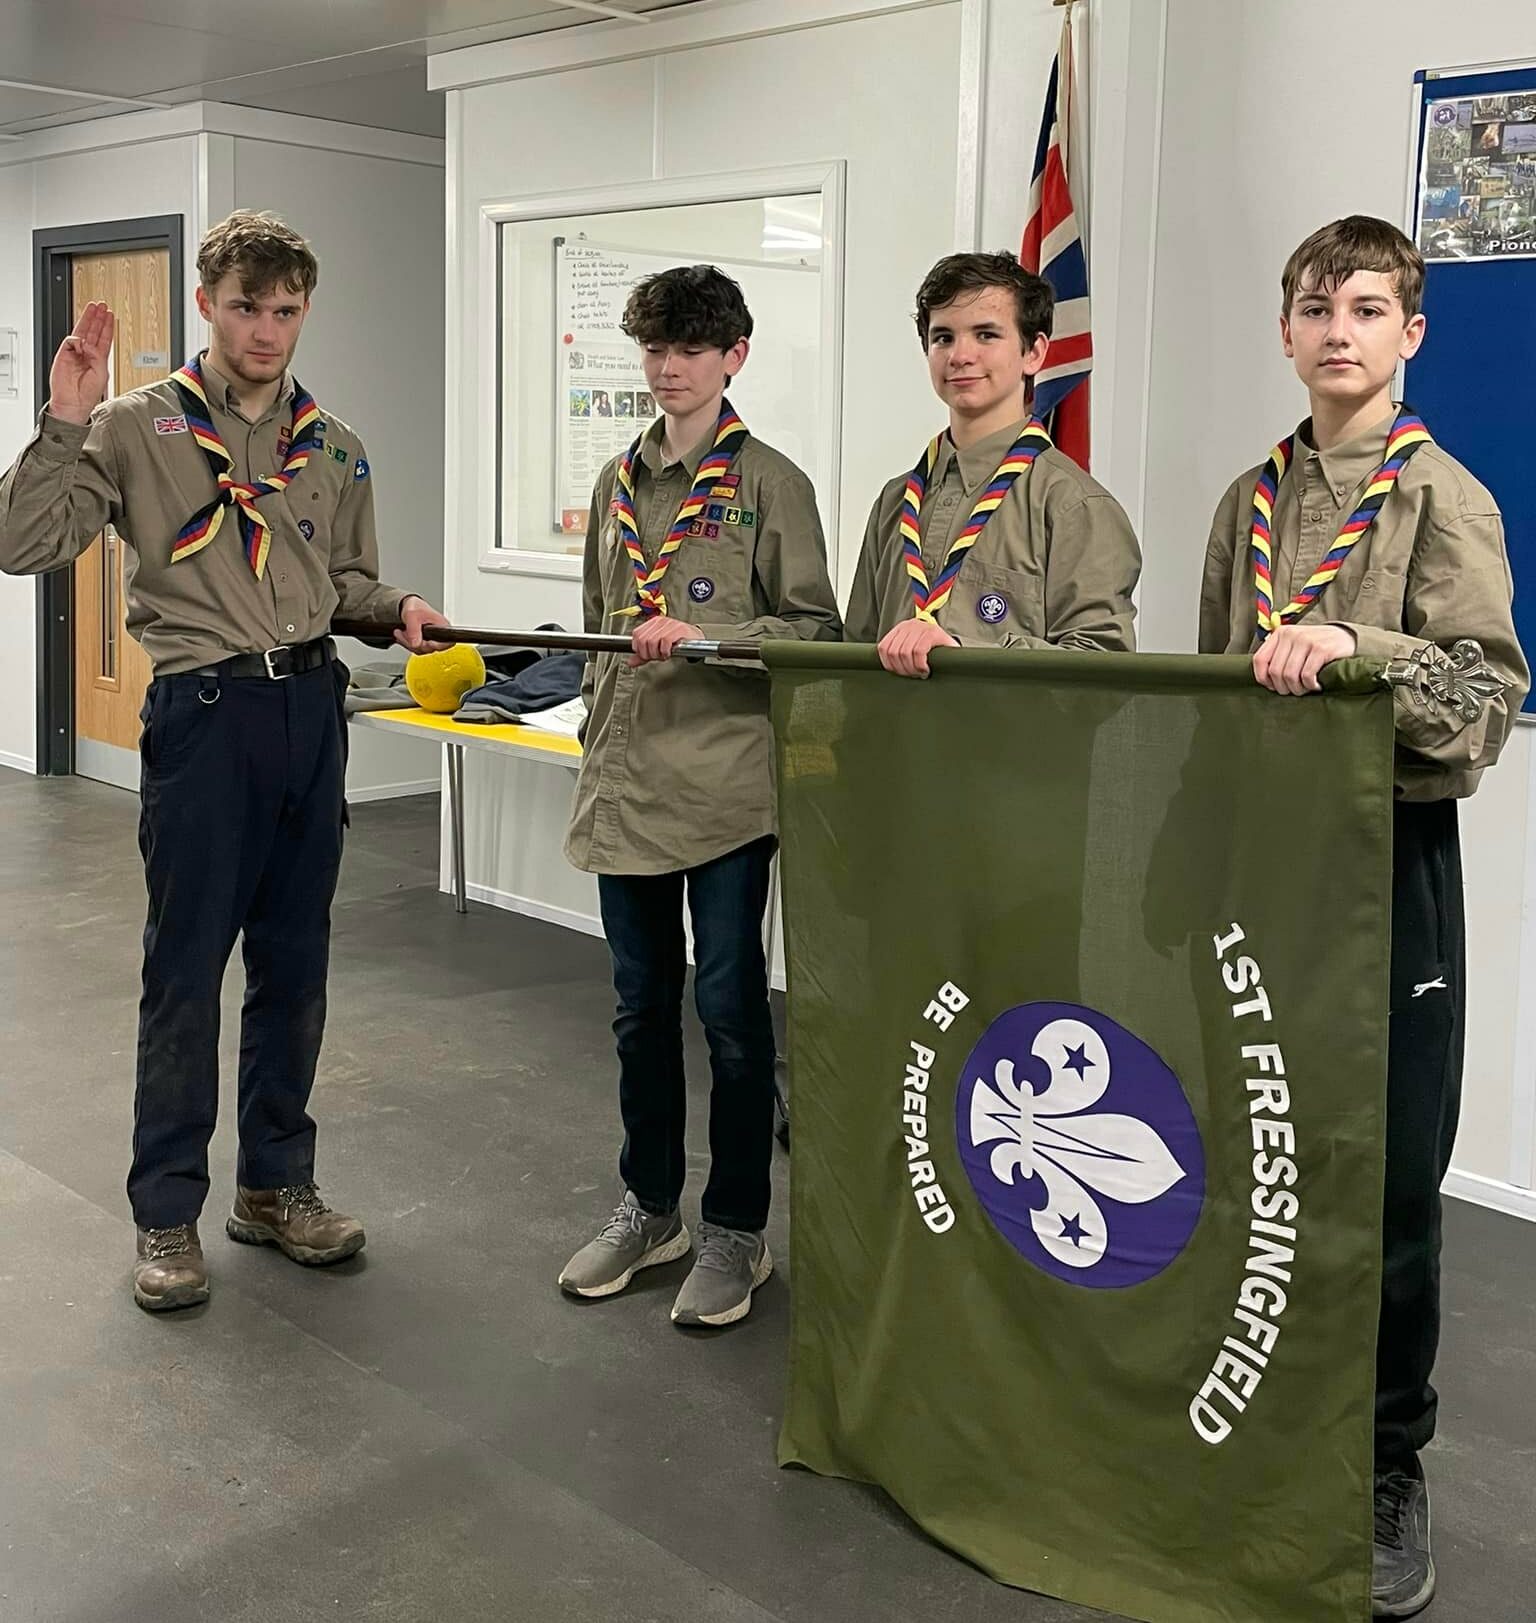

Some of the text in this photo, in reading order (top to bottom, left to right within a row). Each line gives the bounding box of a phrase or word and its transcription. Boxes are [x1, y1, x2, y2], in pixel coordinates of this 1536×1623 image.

[903, 981, 970, 1234] BE PREPARED
[1189, 922, 1299, 1445] 1ST FRESSINGFIELD
